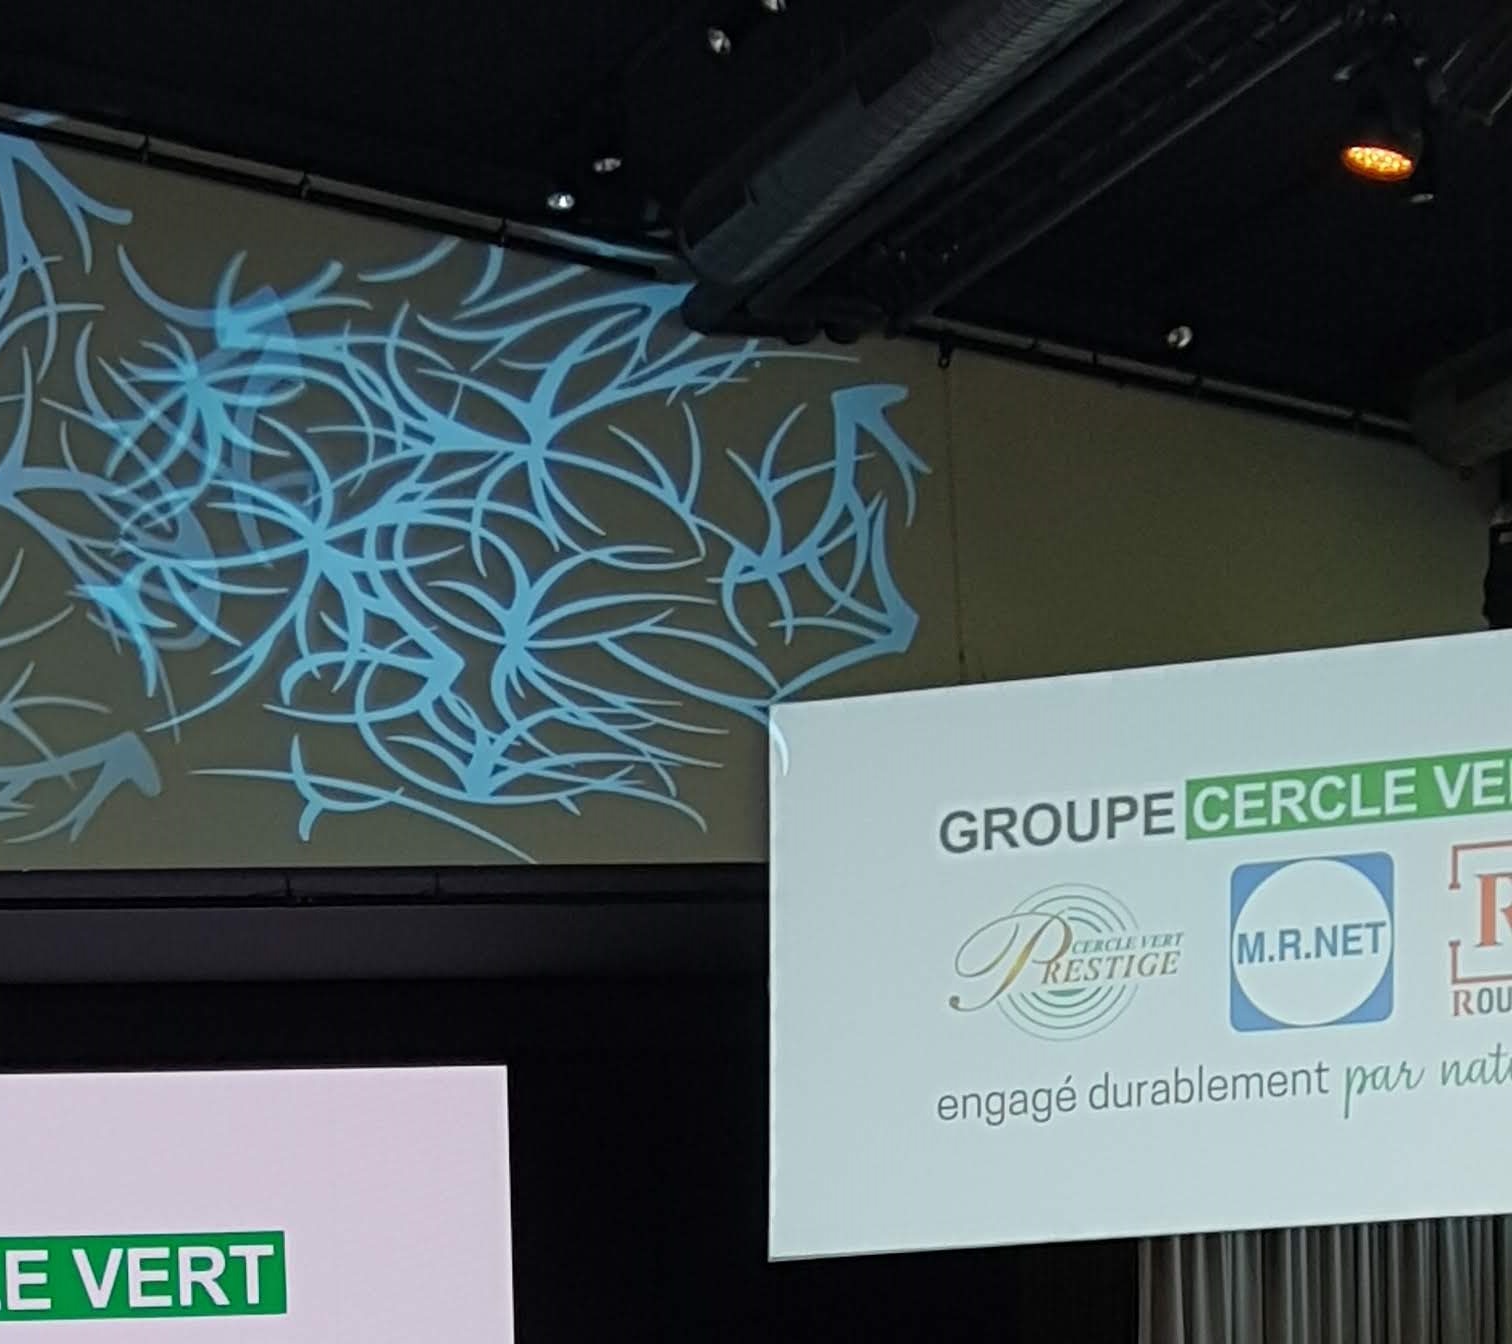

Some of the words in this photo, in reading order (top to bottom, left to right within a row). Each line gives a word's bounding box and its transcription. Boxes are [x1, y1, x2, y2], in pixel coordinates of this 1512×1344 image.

[939, 792, 1176, 854] GROUPE
[1192, 768, 1418, 833] CERCLE
[1433, 759, 1512, 809] VE
[948, 909, 1182, 1013] PRESTIGE
[1071, 936, 1138, 955] CERCLE
[1141, 932, 1185, 949] VERT
[1237, 922, 1388, 966] M.R.NET
[937, 1075, 1078, 1126] engagé
[1088, 1061, 1330, 1112] durablement
[1344, 1060, 1425, 1120] par
[1441, 1042, 1512, 1088] nat
[71, 1244, 274, 1309] VERT
